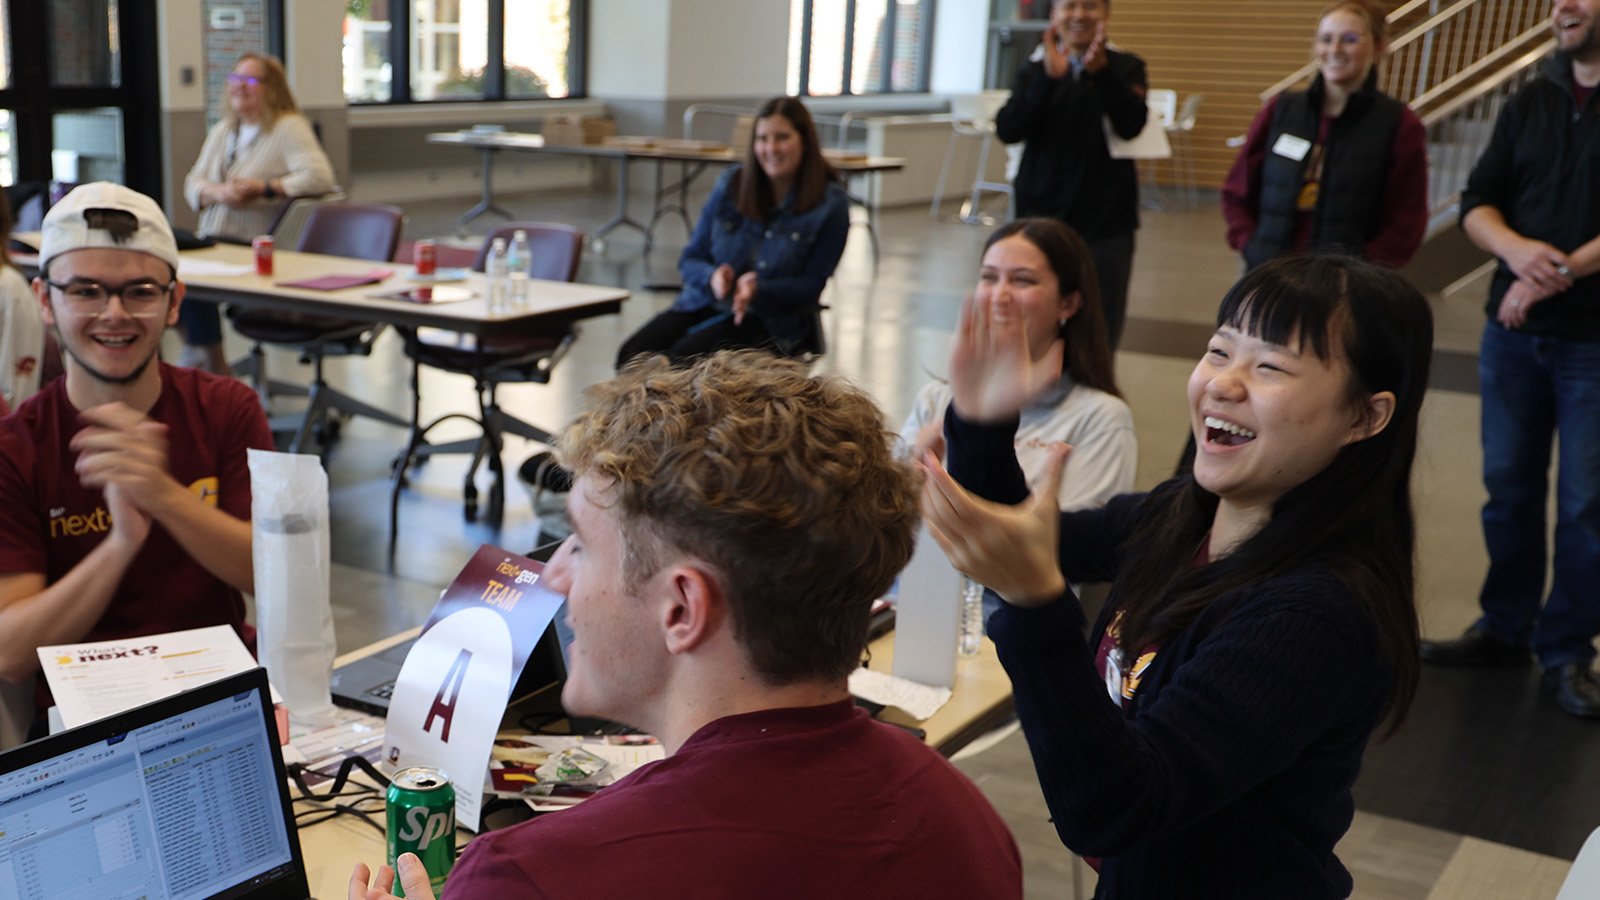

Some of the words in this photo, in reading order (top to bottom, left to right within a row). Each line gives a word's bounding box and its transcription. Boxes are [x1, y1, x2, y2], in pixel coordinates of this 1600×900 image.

[480, 580, 524, 612] TEAM
[79, 645, 159, 663] next?
[422, 648, 473, 744] A
